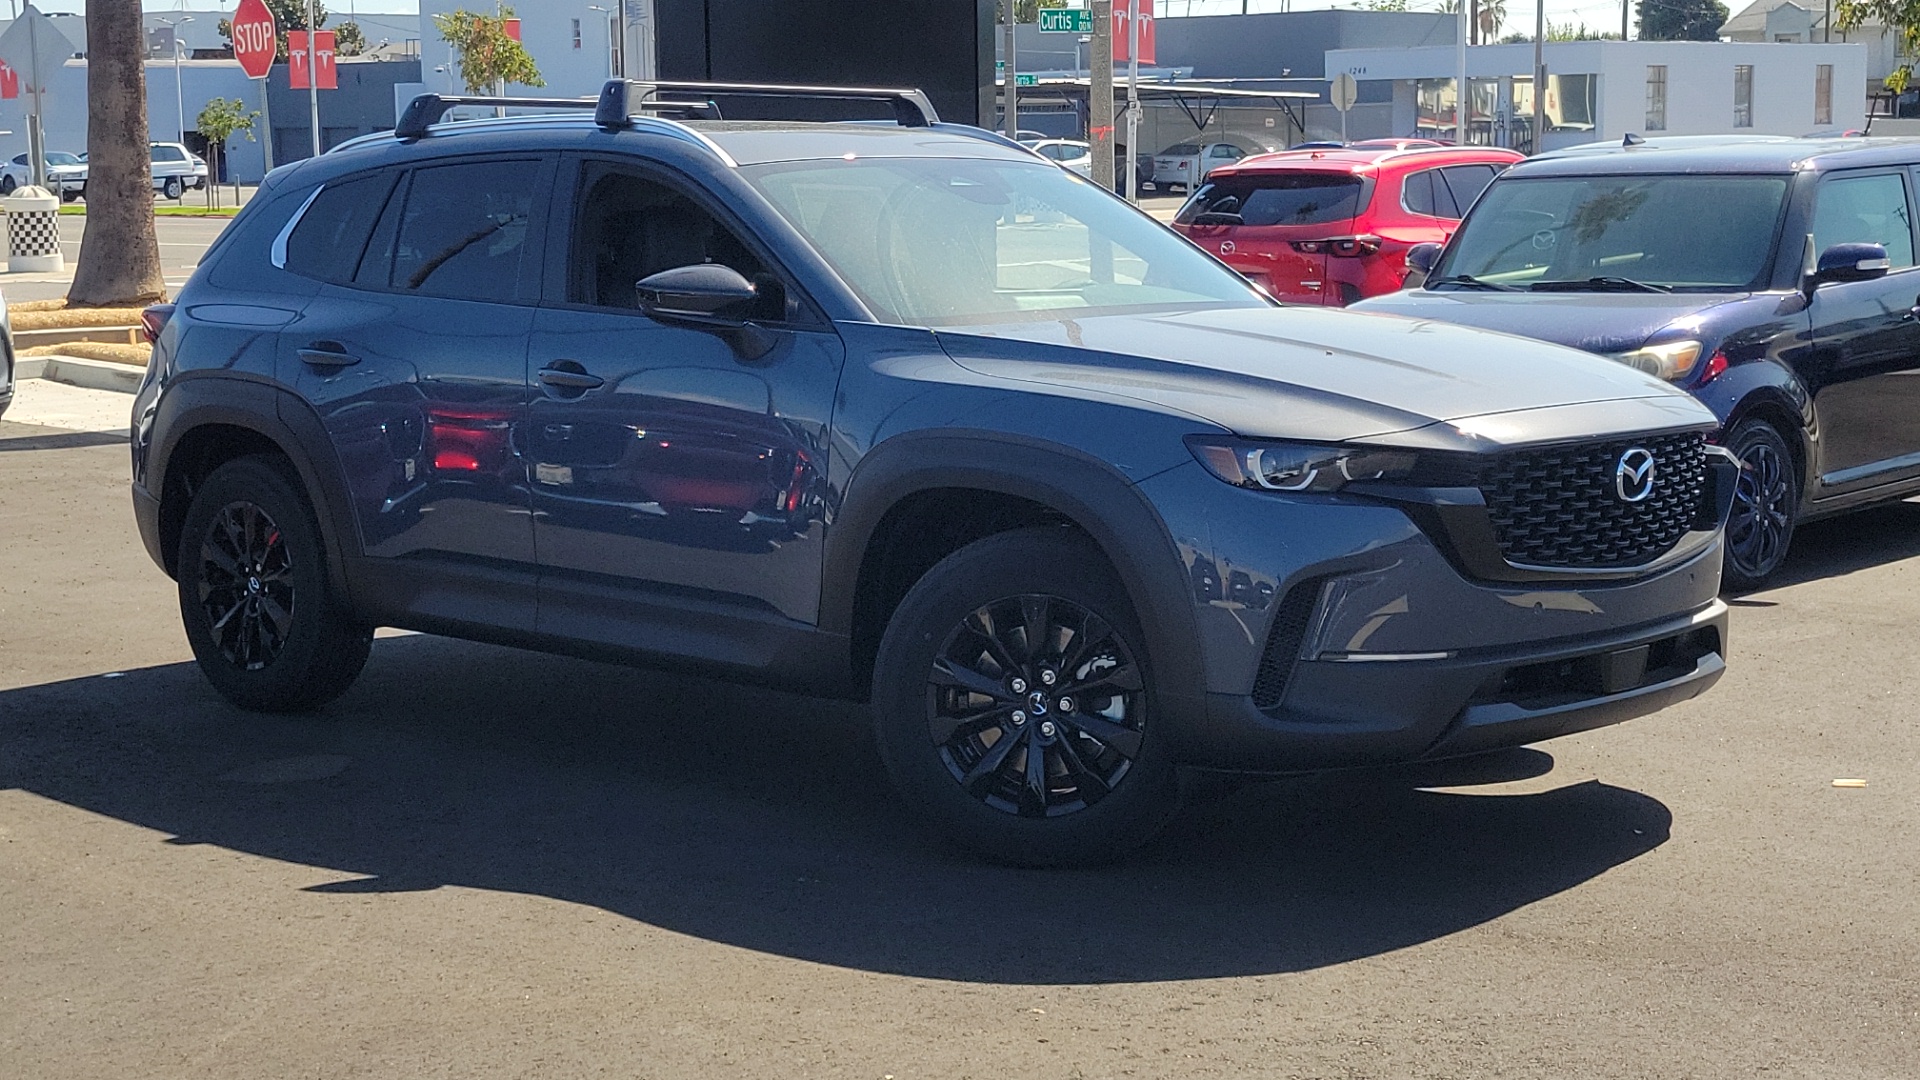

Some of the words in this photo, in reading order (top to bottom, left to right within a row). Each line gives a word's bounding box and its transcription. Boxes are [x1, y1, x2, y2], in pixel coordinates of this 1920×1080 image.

[1041, 11, 1072, 30] Curtis
[1079, 11, 1090, 20] AVE
[235, 21, 272, 54] STOP
